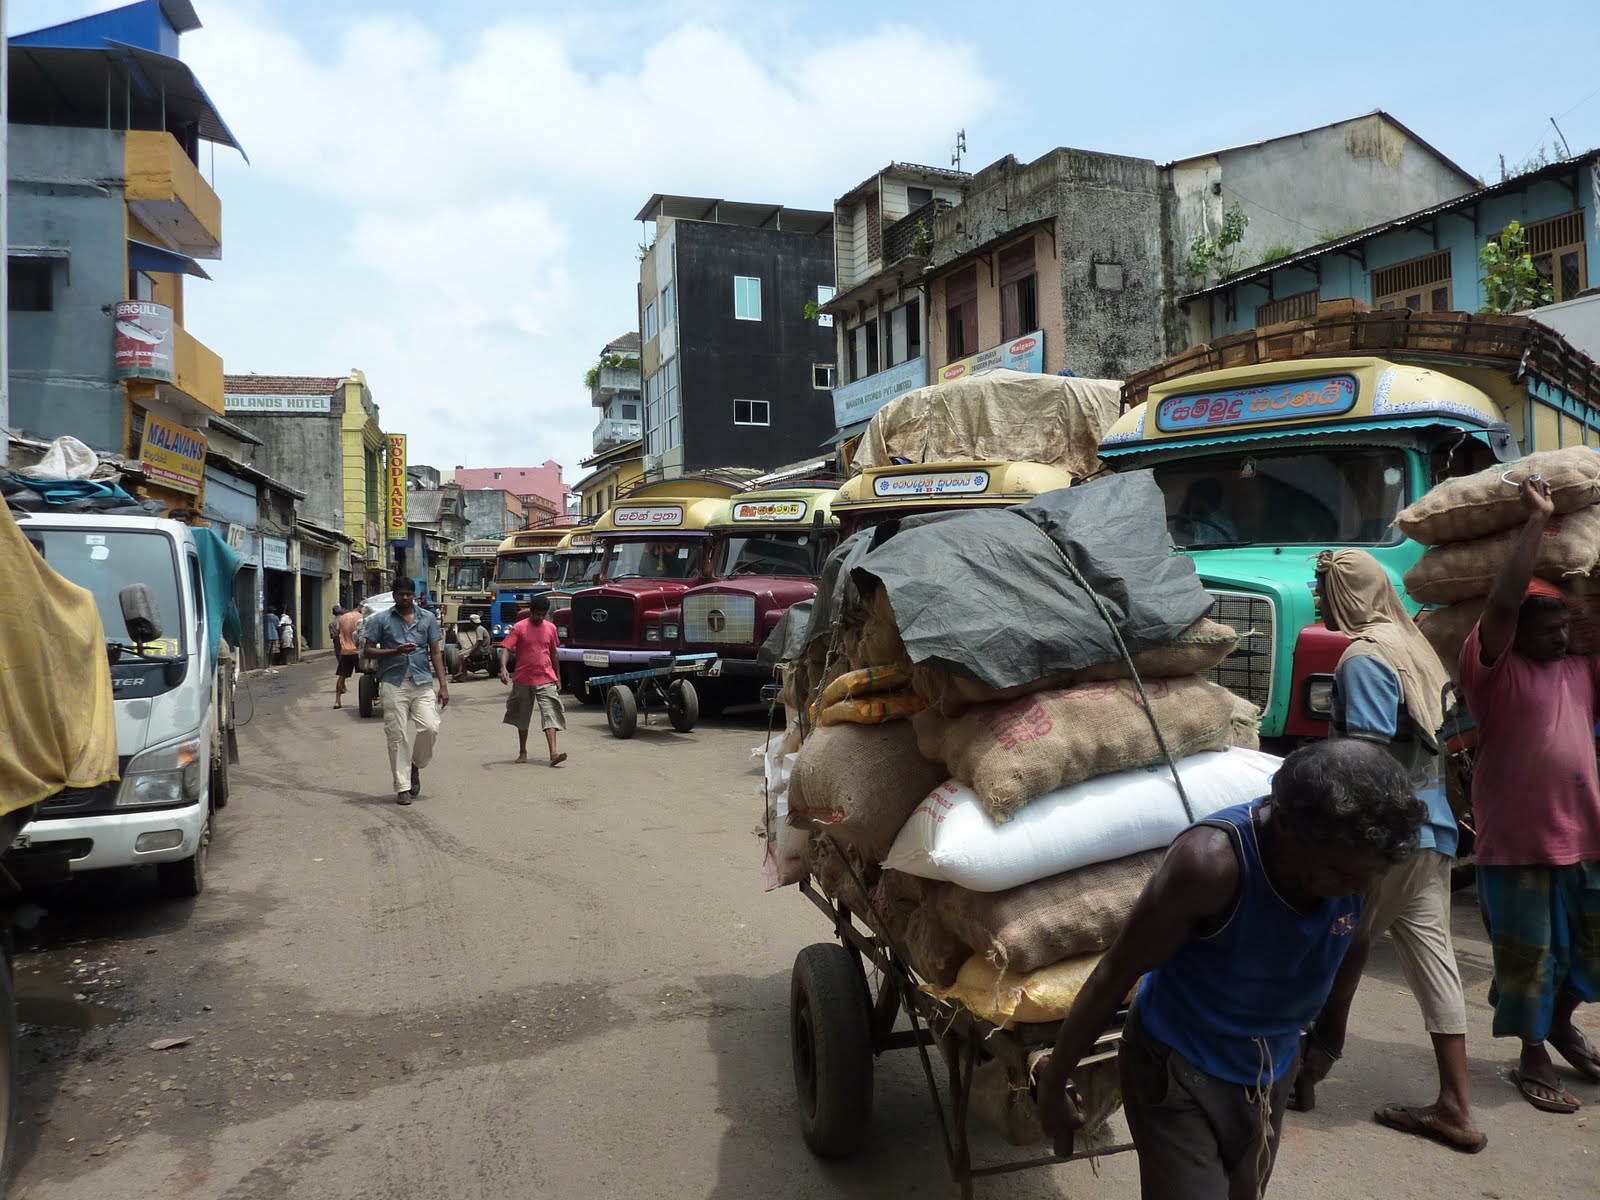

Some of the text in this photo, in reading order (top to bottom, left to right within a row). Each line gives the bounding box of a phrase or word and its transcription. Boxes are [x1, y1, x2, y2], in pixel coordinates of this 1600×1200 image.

[117, 304, 159, 316] SEAGULL
[287, 398, 328, 409] HOTEL
[1250, 383, 1342, 412] සරණයි
[148, 422, 205, 461] MALAVANS
[391, 438, 404, 528] WOODLANDS
